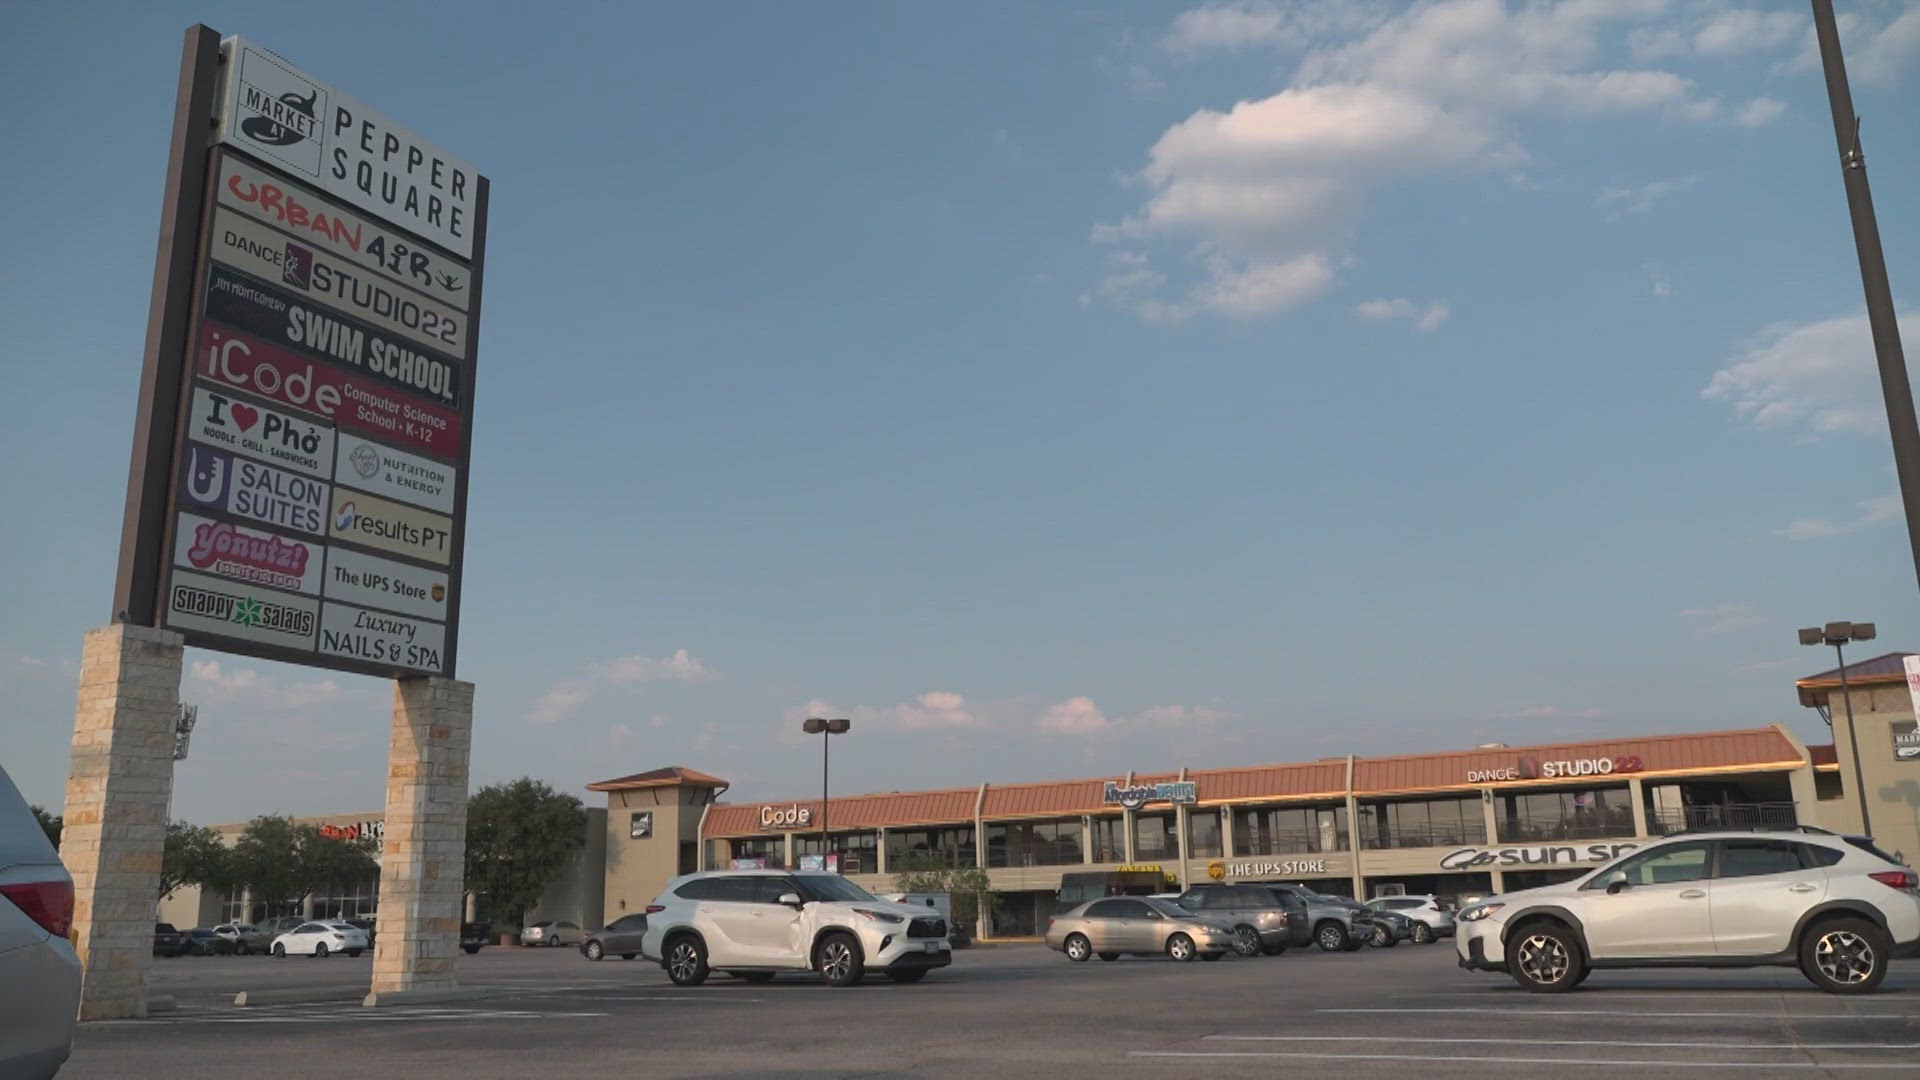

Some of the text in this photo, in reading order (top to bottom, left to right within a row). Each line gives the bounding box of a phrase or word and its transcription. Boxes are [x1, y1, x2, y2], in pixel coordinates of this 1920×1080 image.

[246, 87, 316, 139] MARKET
[270, 123, 285, 140] AT
[335, 105, 466, 201] PEPPER
[228, 175, 362, 252] URBAN
[332, 148, 463, 238] SQUARE
[224, 230, 283, 267] DANCE
[286, 305, 453, 400] SWIM SCHOOL
[208, 332, 342, 415] iCode
[206, 393, 228, 426] I
[343, 383, 447, 430] Computer Science
[357, 405, 432, 443] School K-12
[203, 426, 318, 470] NOODLE GRILL SANDWICHES
[240, 463, 322, 507] SALON
[383, 457, 445, 484] NUTRITION
[396, 475, 442, 496] ENERGY
[235, 489, 320, 532] SUITES
[334, 566, 426, 600] The UPS Store
[176, 589, 310, 632] snappy salads
[354, 611, 417, 644] Luxury
[323, 629, 440, 670] NAILS & SPA
[1467, 767, 1516, 783] DANCE
[1228, 859, 1326, 876] THE UPS STORE
[1499, 846, 1577, 866] sun
